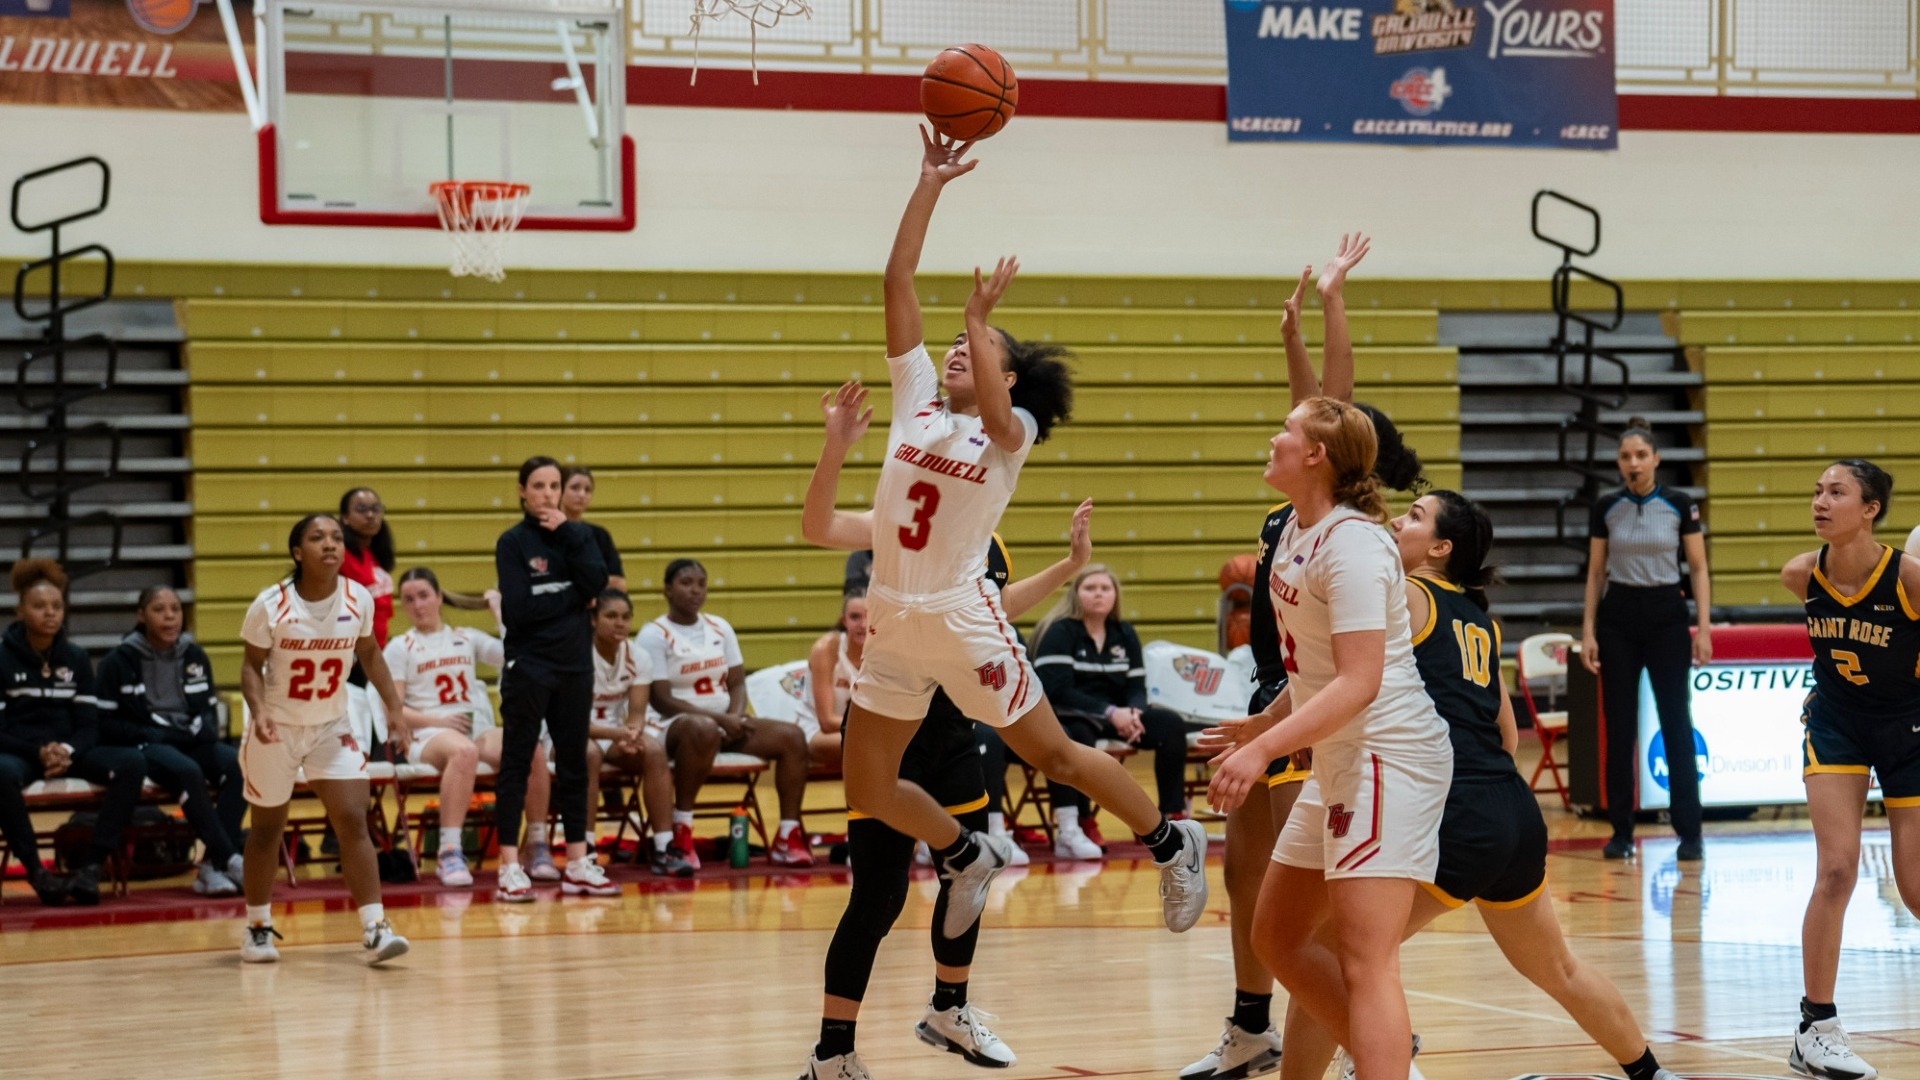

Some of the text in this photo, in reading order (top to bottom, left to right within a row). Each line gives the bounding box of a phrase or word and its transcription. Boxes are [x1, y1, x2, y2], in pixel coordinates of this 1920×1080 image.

[1258, 6, 1362, 41] MAKE
[1374, 28, 1473, 54] UNIVERSITY
[1483, 0, 1604, 60] YOURS
[0, 36, 177, 78] LDWELL
[897, 479, 941, 552] 3
[1807, 616, 1893, 648] SAINT ROSE
[1452, 618, 1492, 689] 10
[1830, 648, 1870, 687] 2
[287, 657, 344, 701] 23
[434, 670, 472, 705] 21
[1693, 669, 1817, 691] OSITIVE
[1711, 754, 1779, 773] Division
